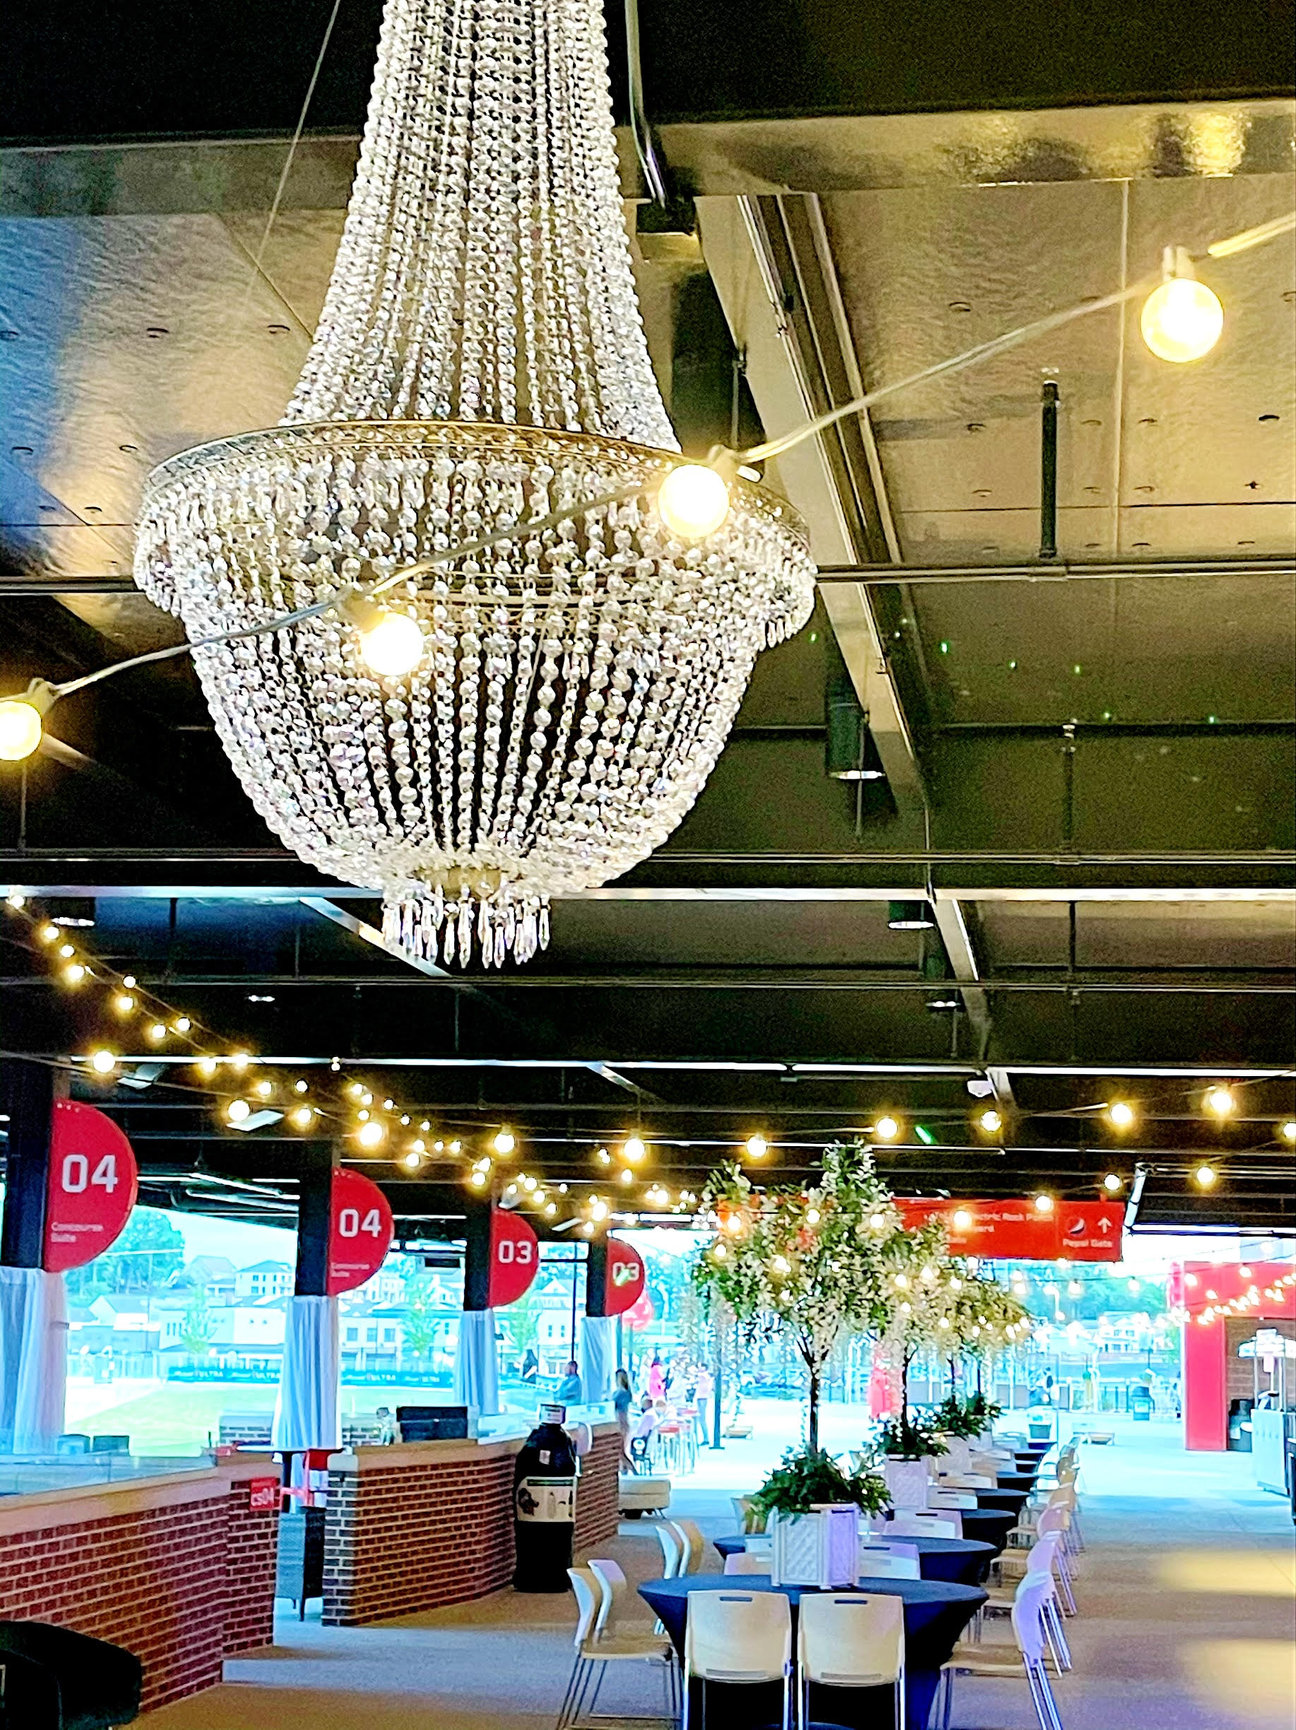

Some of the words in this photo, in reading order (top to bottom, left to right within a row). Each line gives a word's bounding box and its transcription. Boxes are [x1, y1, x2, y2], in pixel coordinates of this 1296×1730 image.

[62, 1153, 119, 1194] 04
[339, 1208, 382, 1238] 04
[498, 1240, 532, 1264] 03
